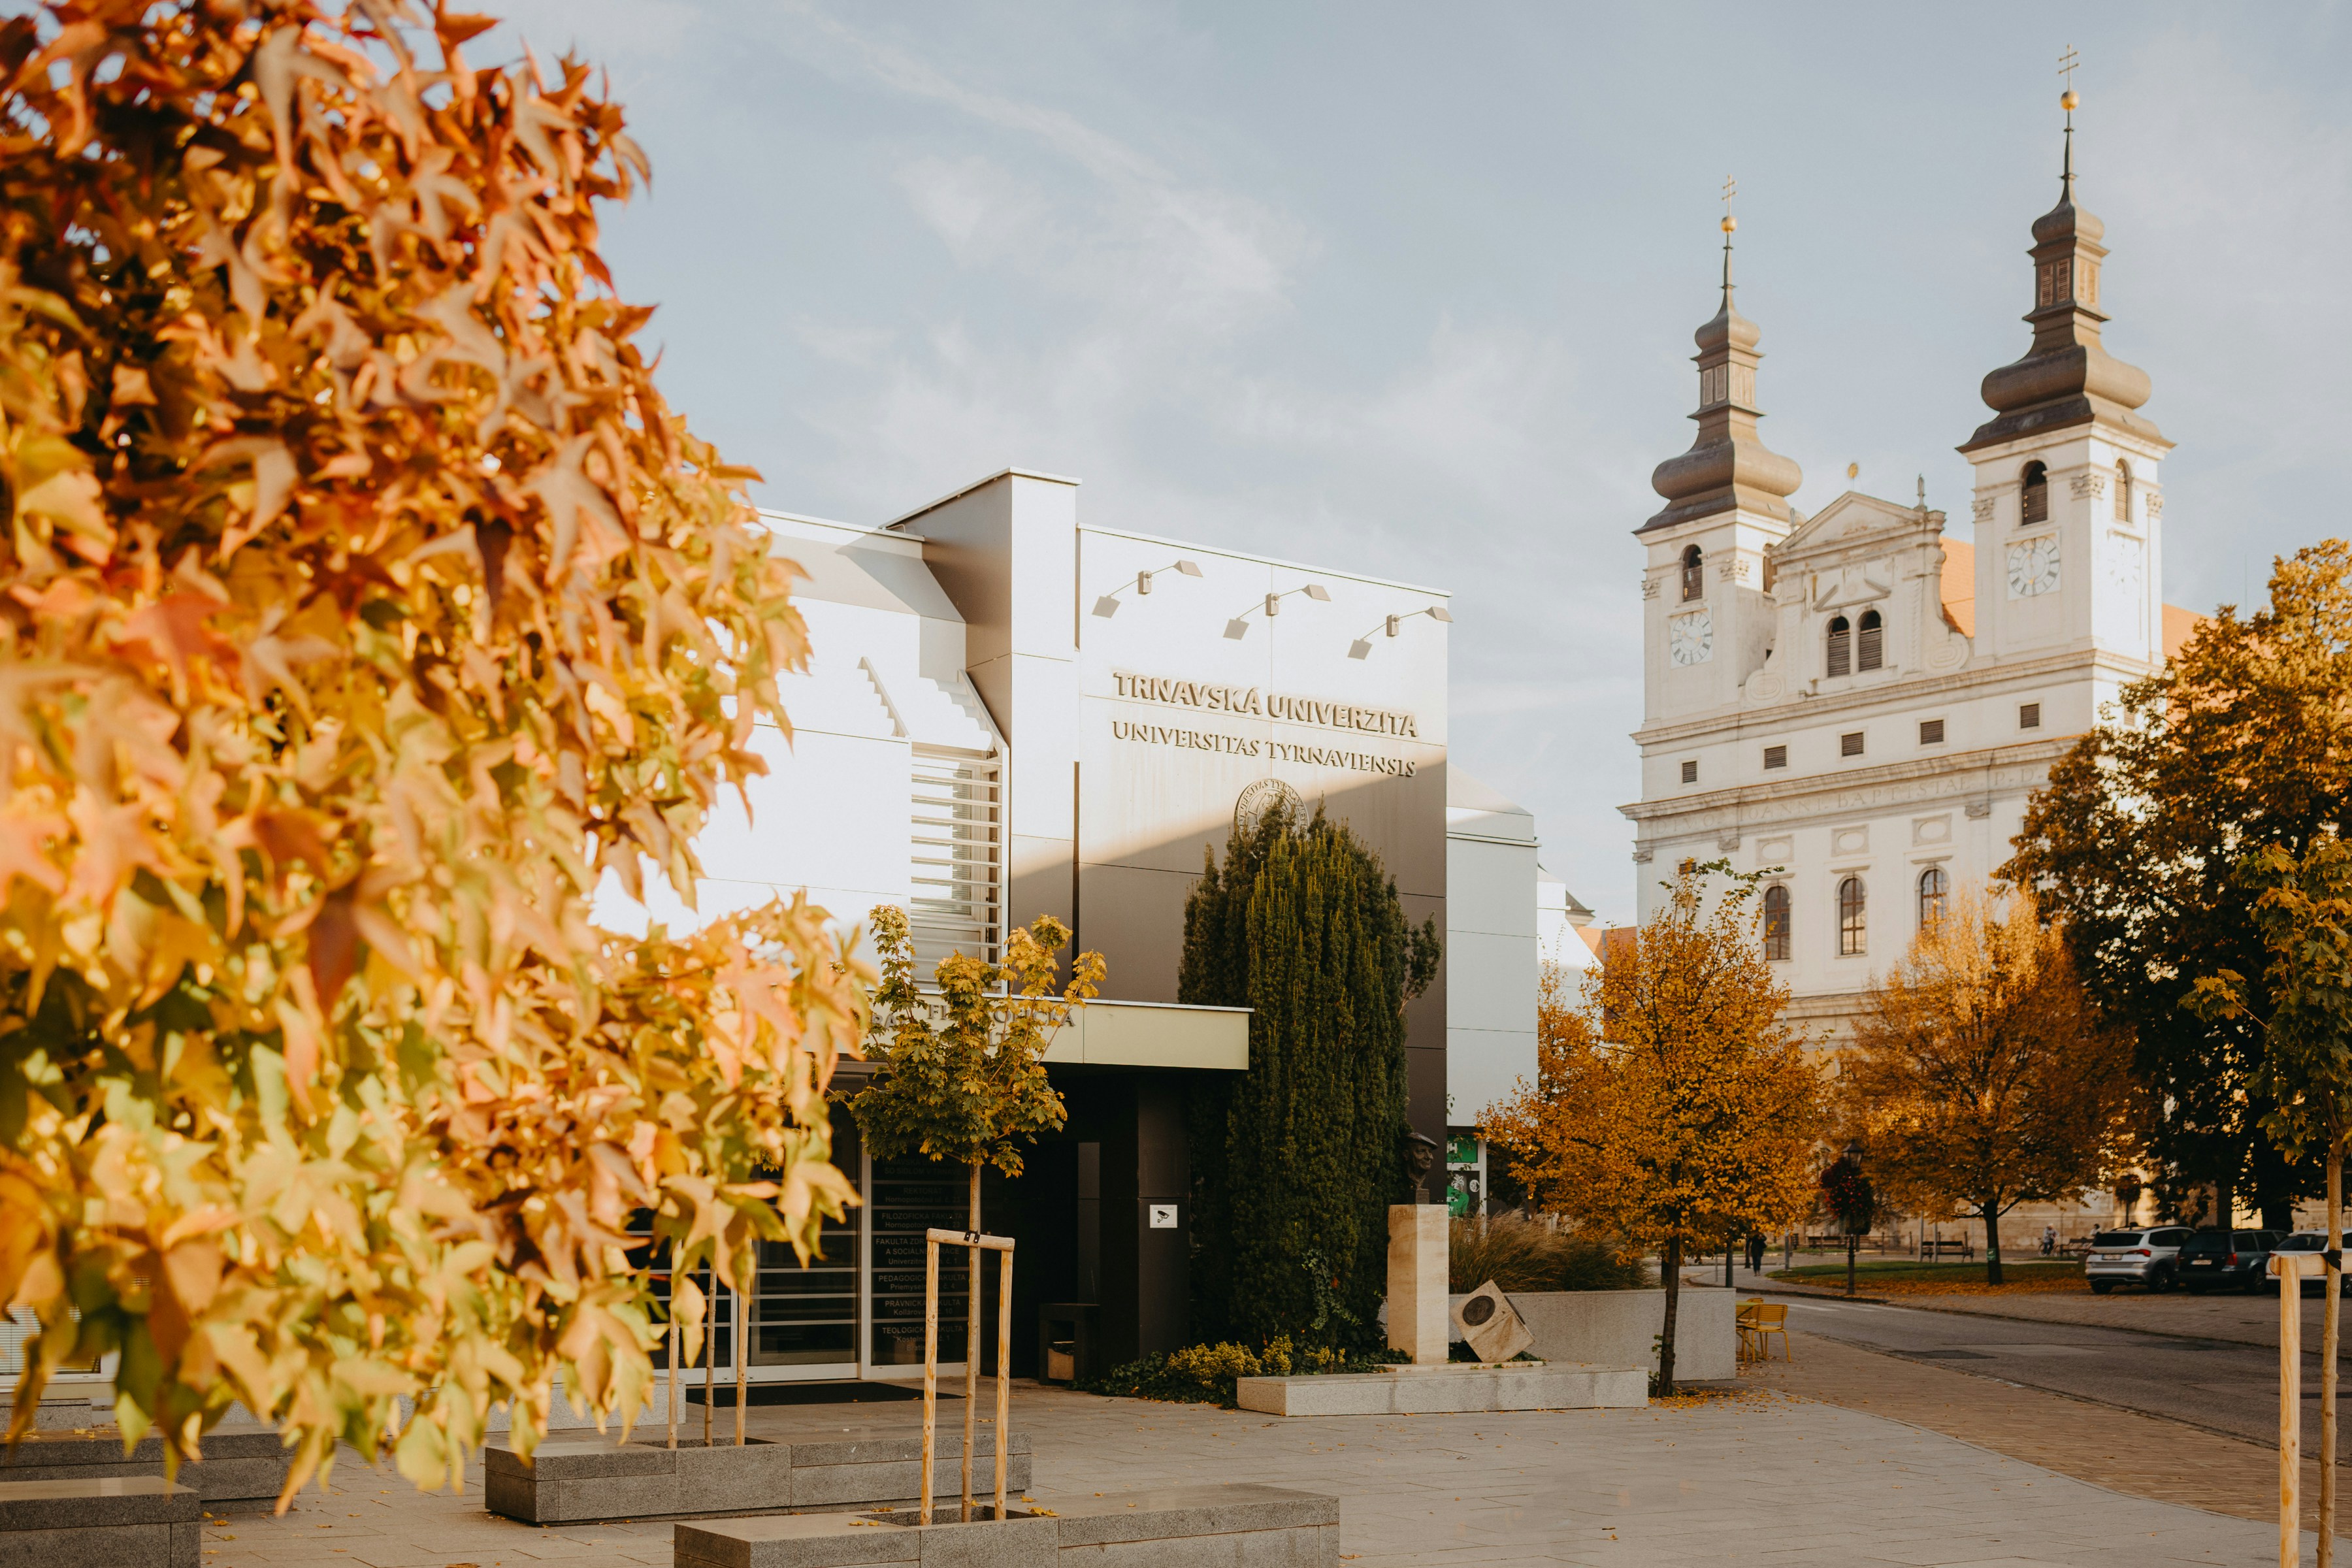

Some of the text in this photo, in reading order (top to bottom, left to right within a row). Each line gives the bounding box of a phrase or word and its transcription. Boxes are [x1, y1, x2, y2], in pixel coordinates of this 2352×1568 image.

[1113, 671, 1419, 738] TRNAVSKÁ UNIVERZITA
[1113, 721, 1416, 777] UNIVERSITAS TYRNAVIENSIS
